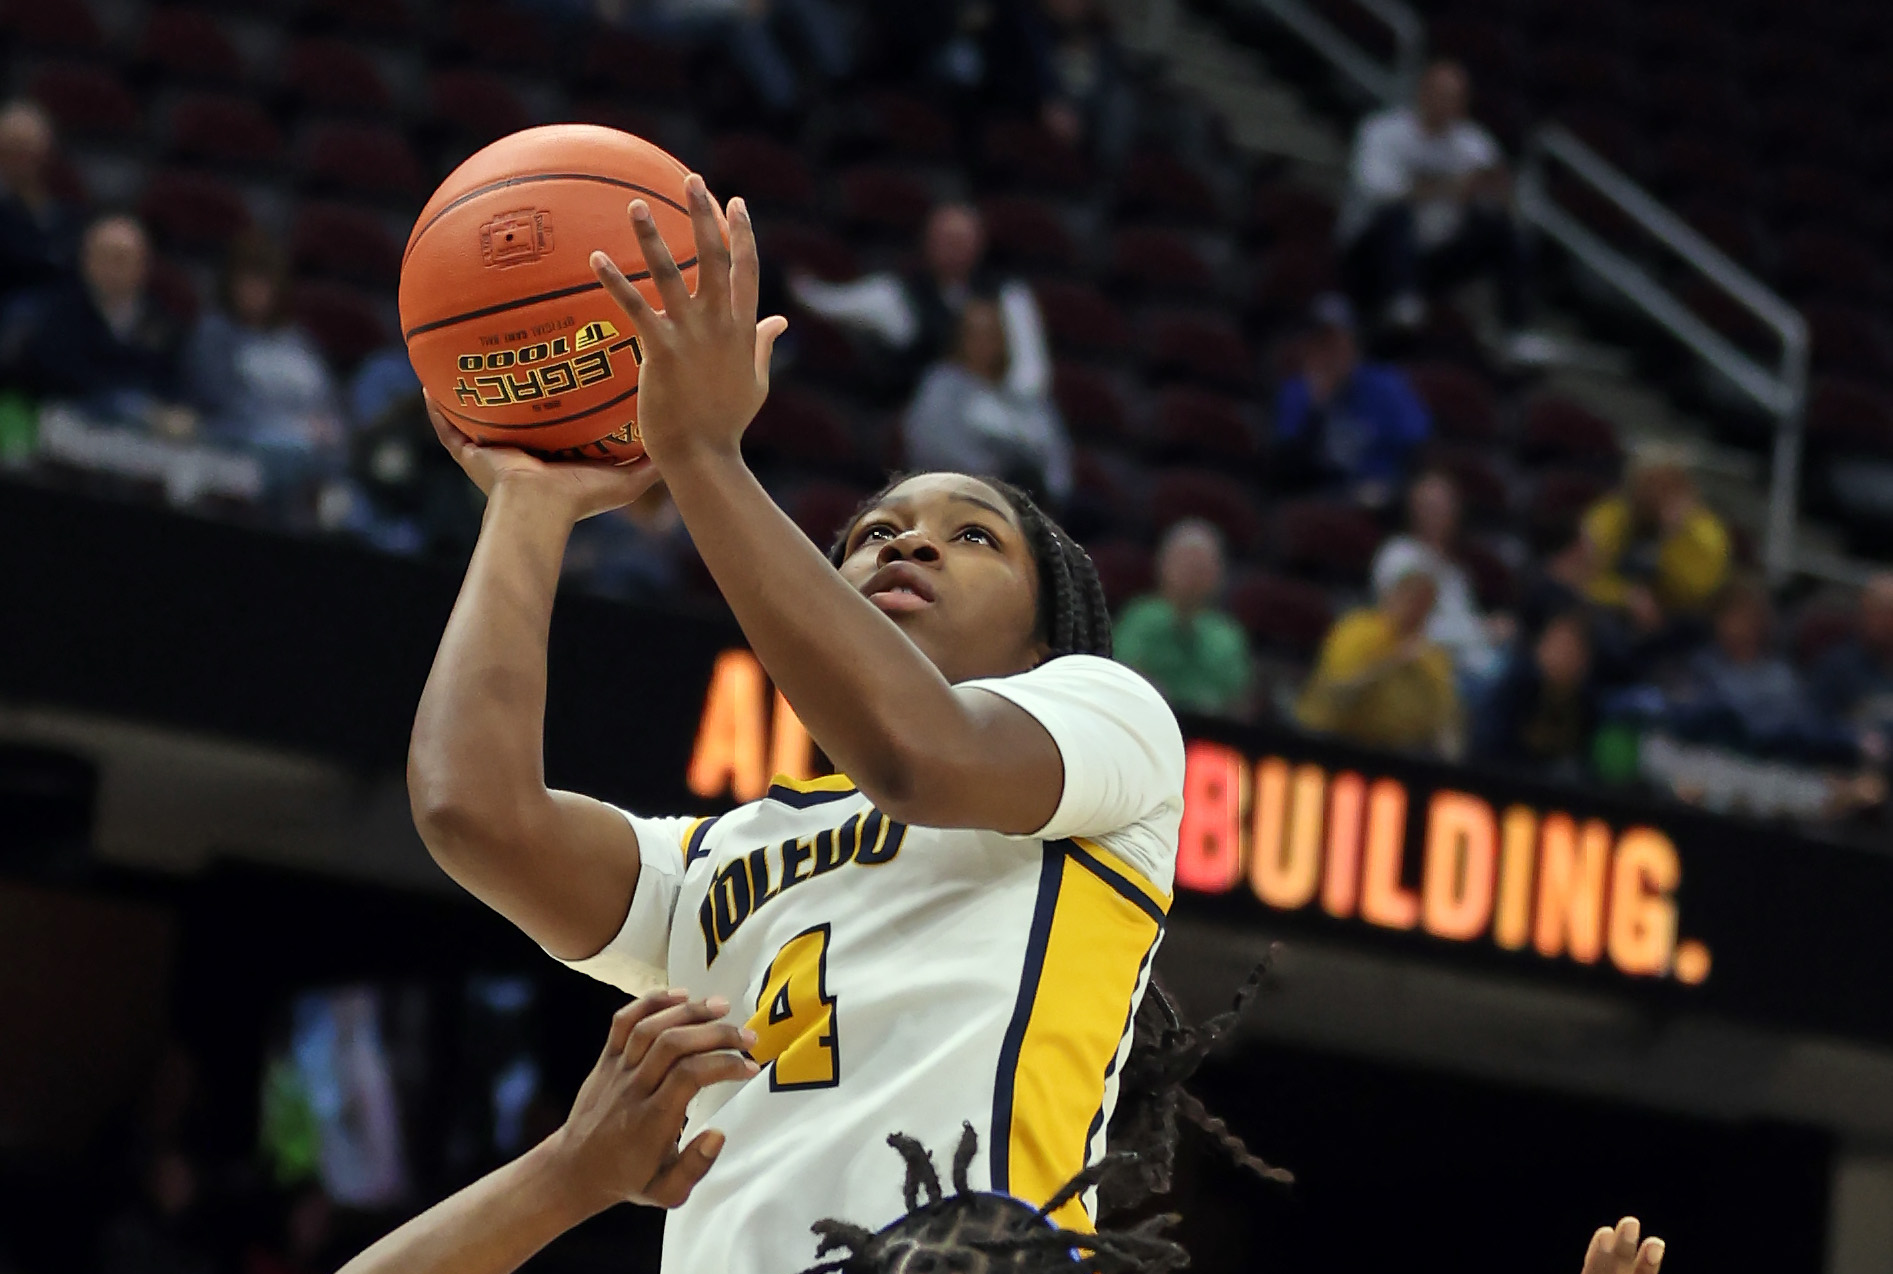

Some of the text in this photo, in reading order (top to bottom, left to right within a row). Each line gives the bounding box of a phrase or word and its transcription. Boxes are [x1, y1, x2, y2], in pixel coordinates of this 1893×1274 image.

[453, 335, 643, 407] LEGACY
[457, 322, 619, 373] TF 1000
[743, 921, 840, 1093] 4
